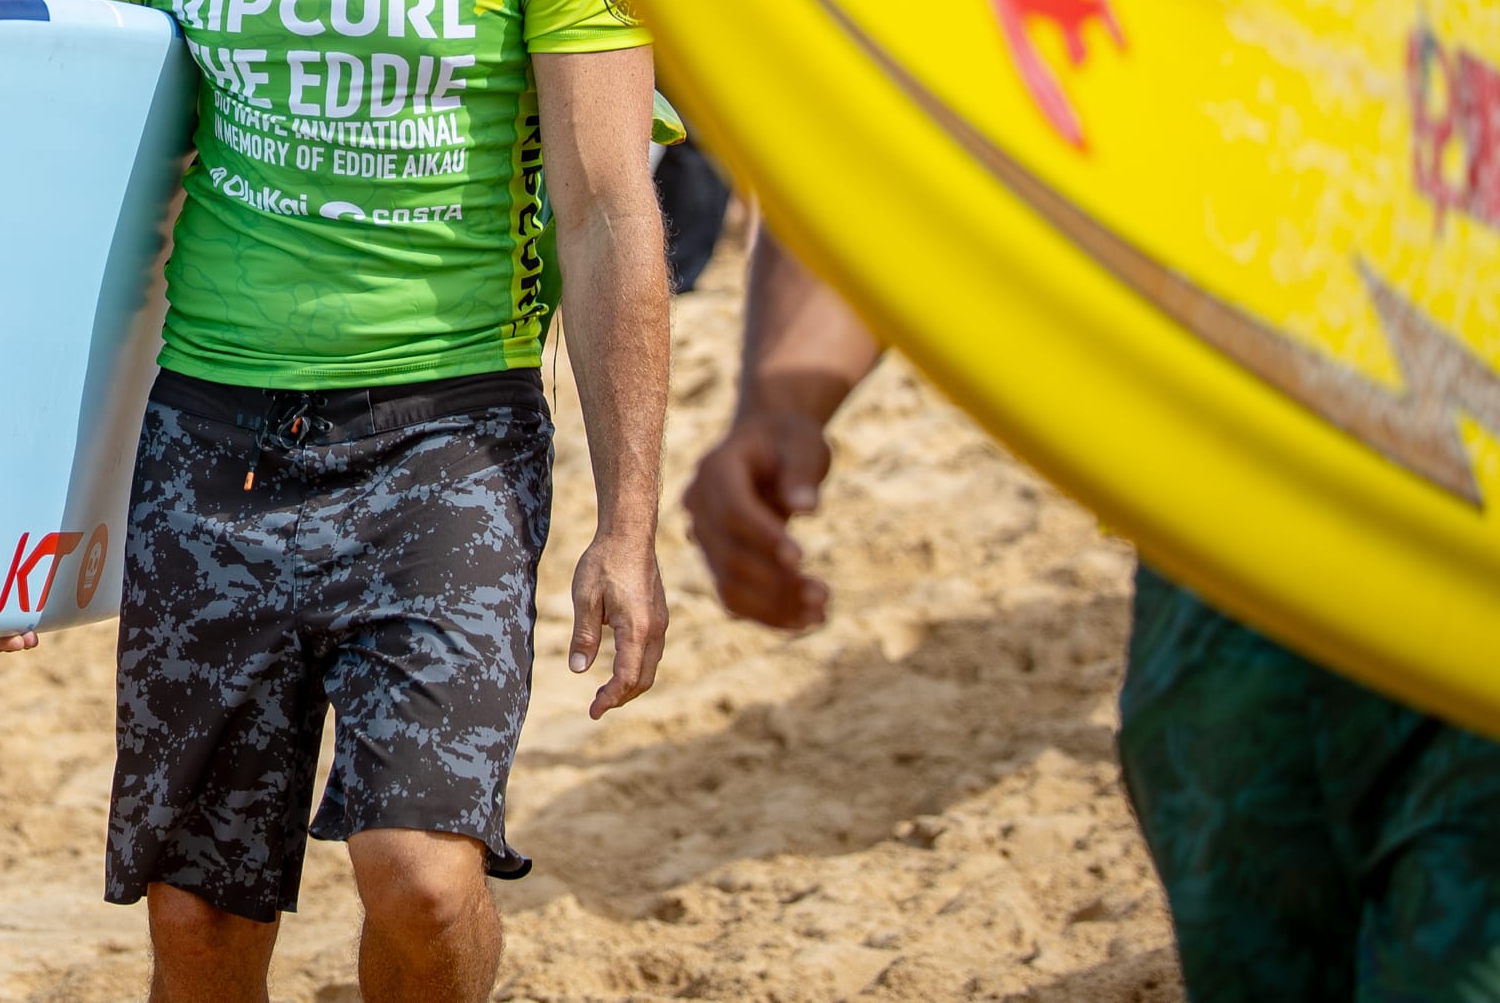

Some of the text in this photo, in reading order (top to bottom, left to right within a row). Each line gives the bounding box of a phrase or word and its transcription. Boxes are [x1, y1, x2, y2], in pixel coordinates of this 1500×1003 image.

[185, 34, 476, 118] THE EDDIE
[223, 119, 288, 167] MEMORY
[296, 145, 324, 172] OF
[333, 149, 397, 179] EDDIE
[402, 148, 466, 179] AIKAU
[231, 99, 288, 137] WAVE
[291, 113, 466, 150] INVITATIONAL
[372, 204, 462, 225] COSTA
